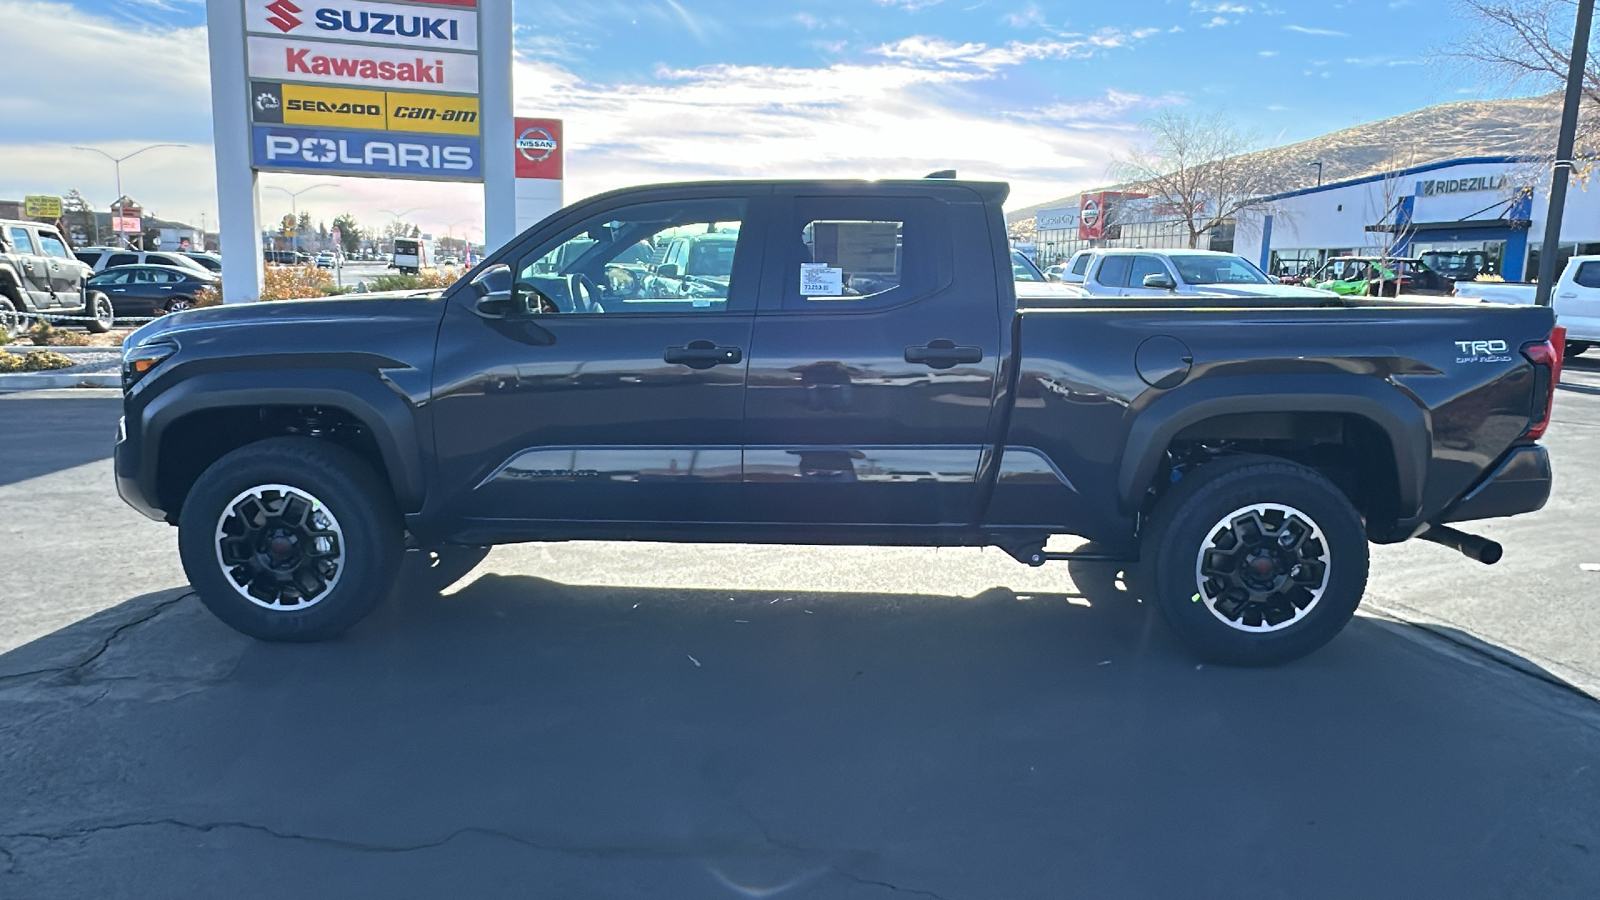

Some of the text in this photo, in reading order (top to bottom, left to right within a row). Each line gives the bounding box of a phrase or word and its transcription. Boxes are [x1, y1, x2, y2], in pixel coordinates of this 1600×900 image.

[315, 8, 458, 41] SUZUKI
[285, 47, 444, 84] Kawasaki
[393, 106, 477, 123] can-am
[266, 135, 474, 171] POLARIS
[520, 140, 553, 148] NISSAN
[1436, 174, 1507, 194] RIDEZILLA
[1454, 340, 1507, 355] TRD
